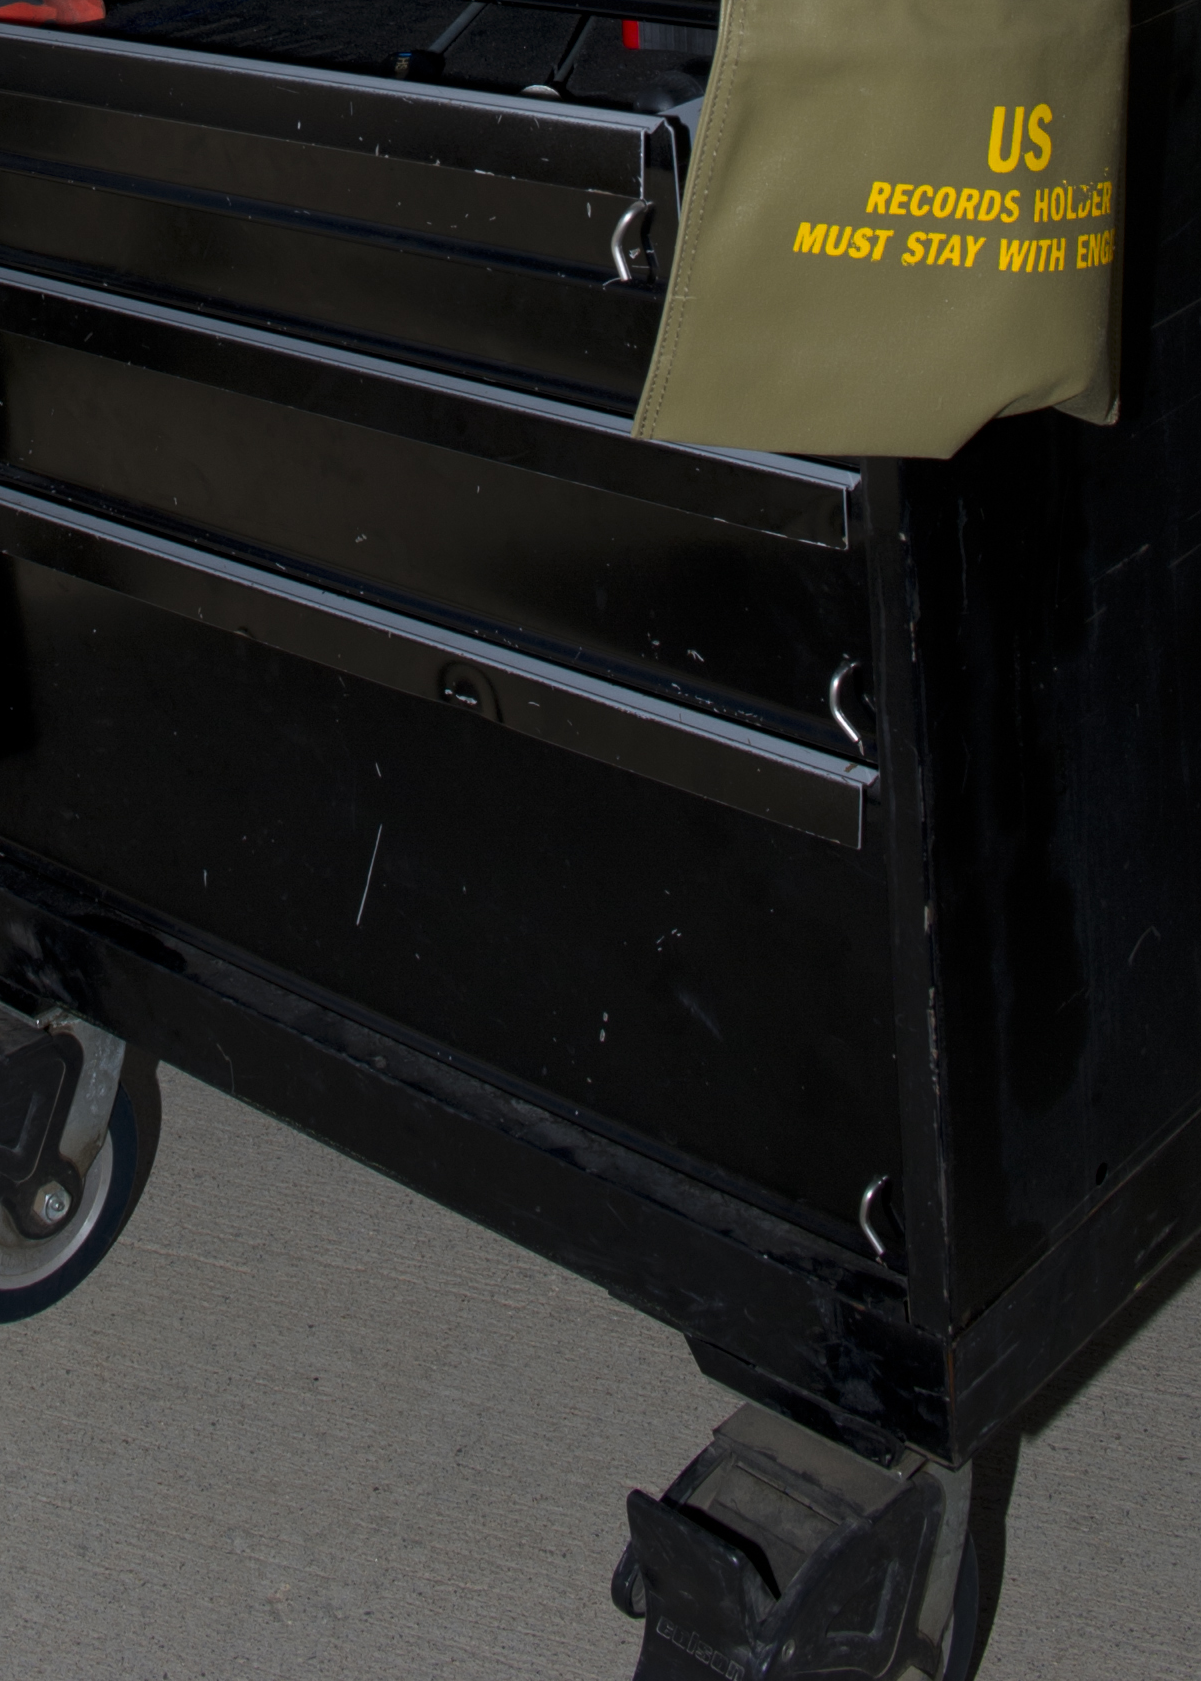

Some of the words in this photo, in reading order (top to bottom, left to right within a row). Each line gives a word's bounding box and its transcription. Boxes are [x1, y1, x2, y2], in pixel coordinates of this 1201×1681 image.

[988, 104, 1053, 173] US
[866, 181, 1021, 224] RECORDS
[1034, 181, 1113, 223] HOLDER
[793, 222, 894, 262] MUST
[902, 231, 986, 268] STAY
[999, 237, 1066, 273] WITH
